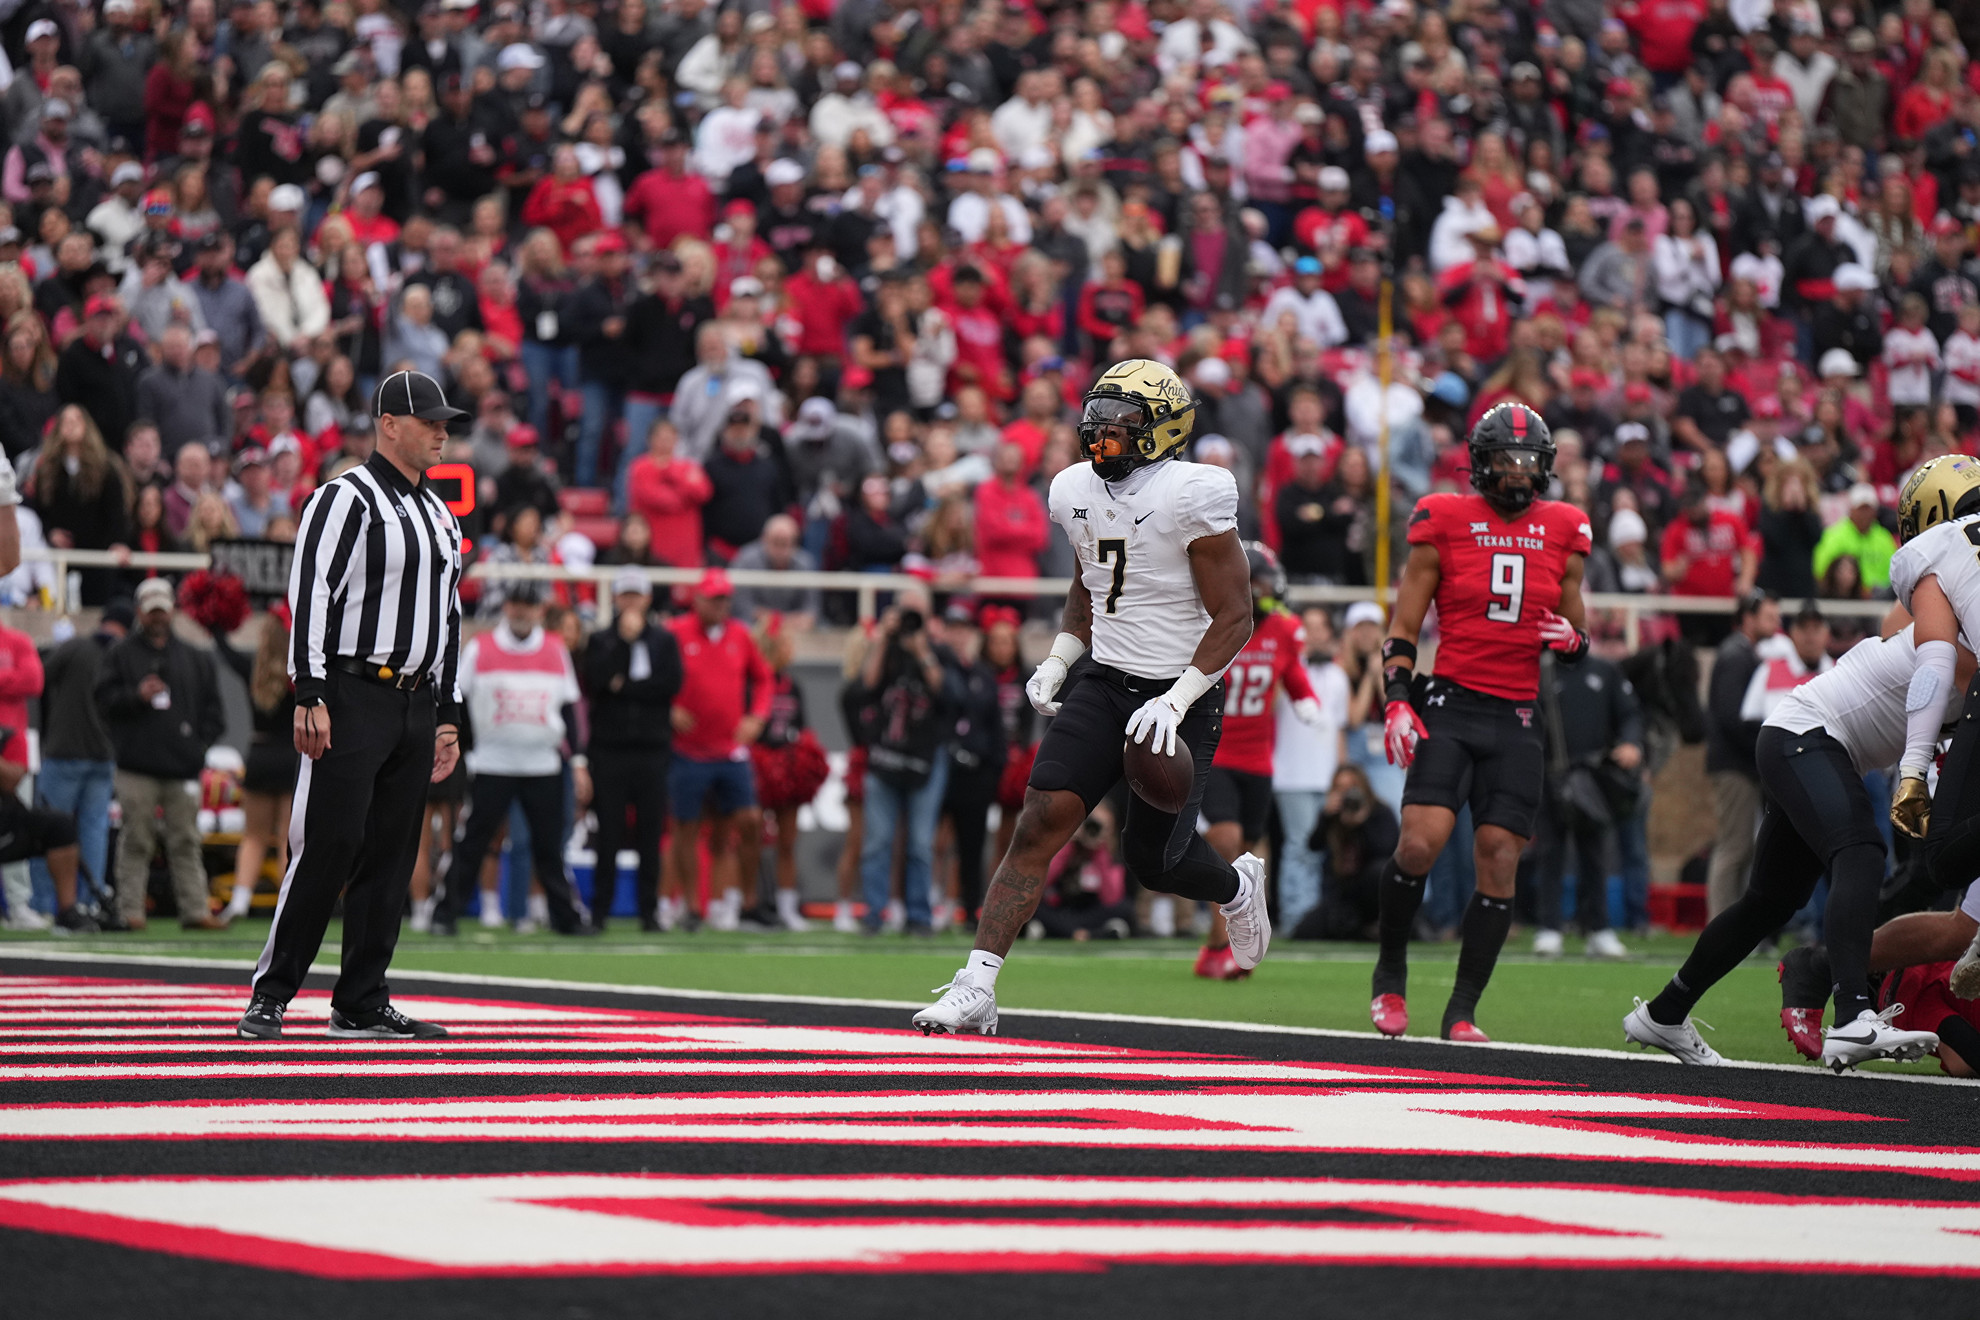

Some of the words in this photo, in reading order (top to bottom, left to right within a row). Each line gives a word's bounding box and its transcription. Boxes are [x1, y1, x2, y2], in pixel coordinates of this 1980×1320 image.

[1475, 535, 1513, 547] TEXAS
[1516, 536, 1544, 551] TECH
[1098, 538, 1127, 615] 7
[1486, 553, 1525, 623] 9
[1224, 665, 1273, 717] 12
